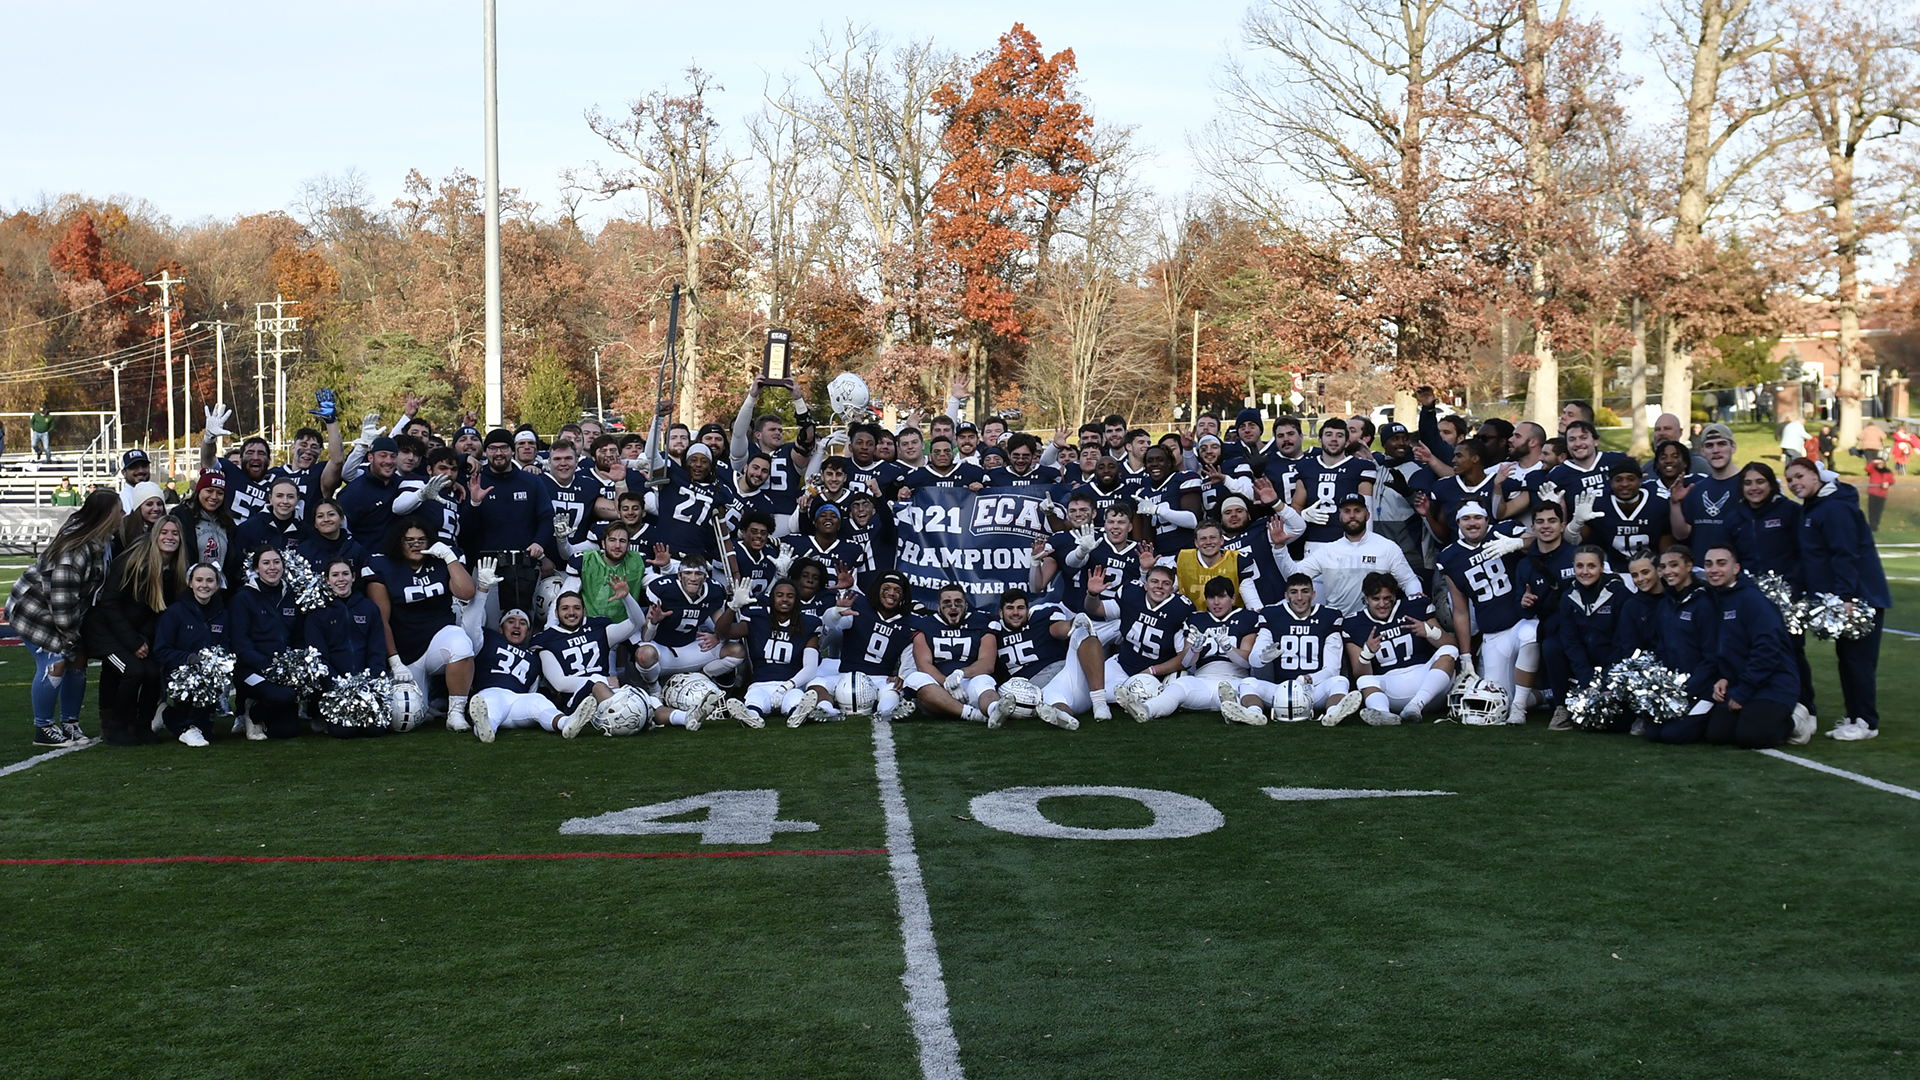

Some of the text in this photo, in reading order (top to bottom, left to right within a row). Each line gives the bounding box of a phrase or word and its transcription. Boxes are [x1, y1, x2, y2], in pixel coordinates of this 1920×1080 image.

[765, 457, 788, 492] 5
[854, 472, 872, 482] FDU
[1319, 473, 1337, 484] FDU
[1581, 475, 1603, 488] FDU
[211, 477, 226, 487] FDU
[245, 485, 266, 502] FDU
[513, 491, 528, 501] FDU
[557, 491, 575, 501] FDU
[673, 486, 714, 527] 27
[1096, 499, 1115, 509] FDU
[1616, 525, 1639, 536] FDU
[852, 533, 871, 547] FDU
[1224, 541, 1242, 551] FDU
[1107, 557, 1126, 571] FDU
[1362, 556, 1377, 564] FDU
[1463, 558, 1513, 603] 58
[682, 609, 700, 619] FDU
[1137, 612, 1158, 626] FDU
[873, 621, 894, 637] FDU
[941, 629, 961, 638] FDU
[1290, 625, 1310, 635] FDU
[567, 633, 589, 649] FDU
[1002, 632, 1024, 646] FDU
[1126, 621, 1165, 661] 45
[507, 643, 526, 659] FDU
[762, 637, 794, 665] 10
[863, 636, 890, 665] 9
[932, 636, 973, 664] 57
[1279, 635, 1320, 671] 80
[562, 640, 603, 678] 32
[490, 647, 531, 686] 34
